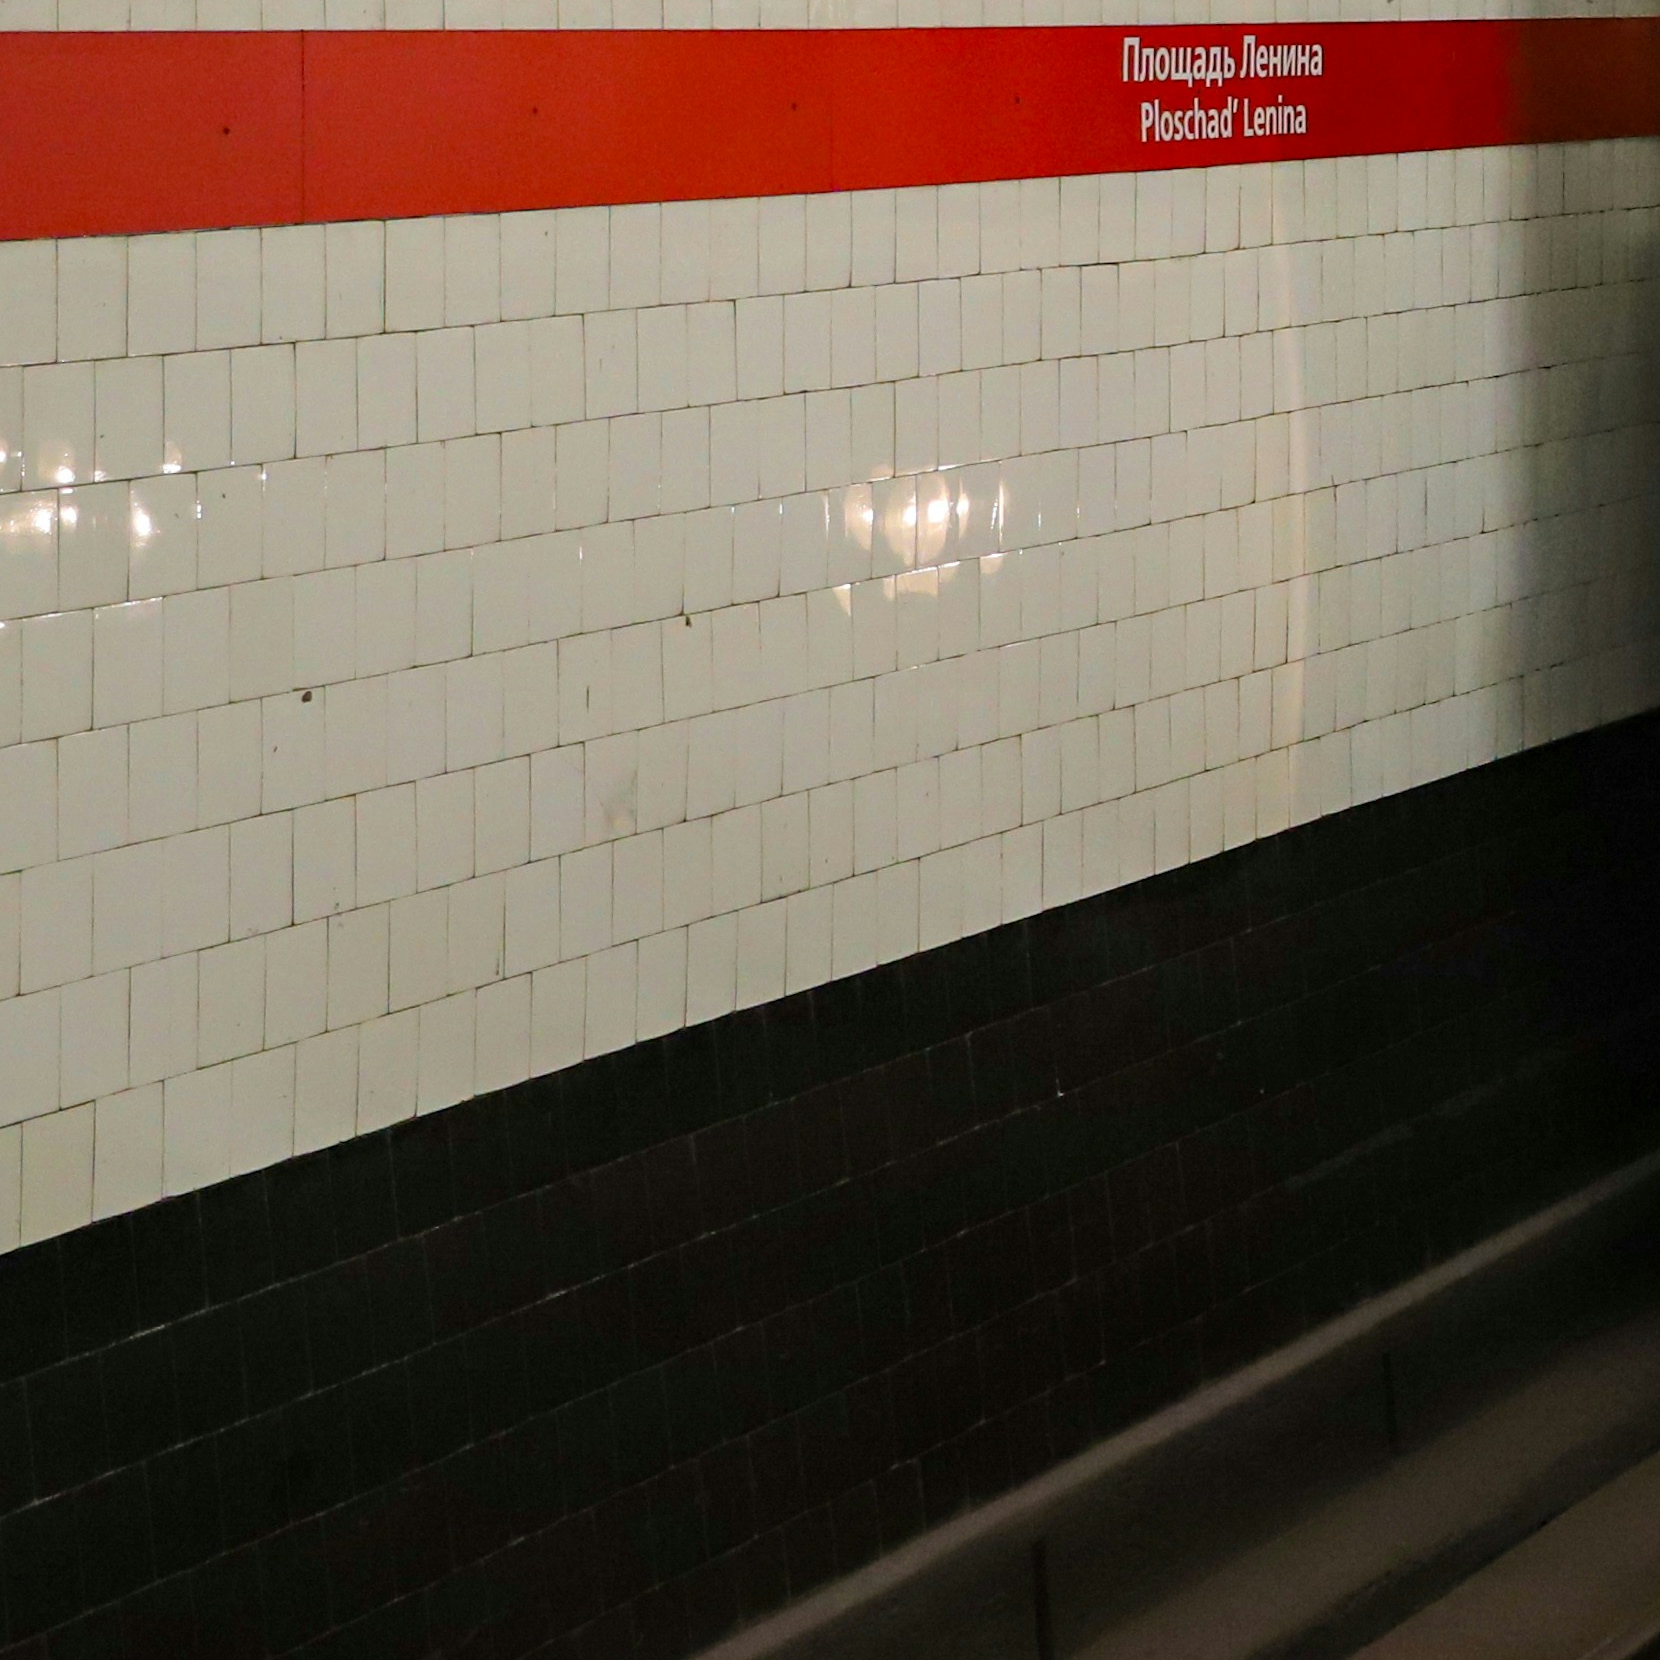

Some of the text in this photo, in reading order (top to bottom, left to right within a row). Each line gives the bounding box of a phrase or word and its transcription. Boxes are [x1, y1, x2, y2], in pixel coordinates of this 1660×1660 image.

[1122, 34, 1323, 88] Площадь Ленина
[1243, 94, 1307, 137] Lenina
